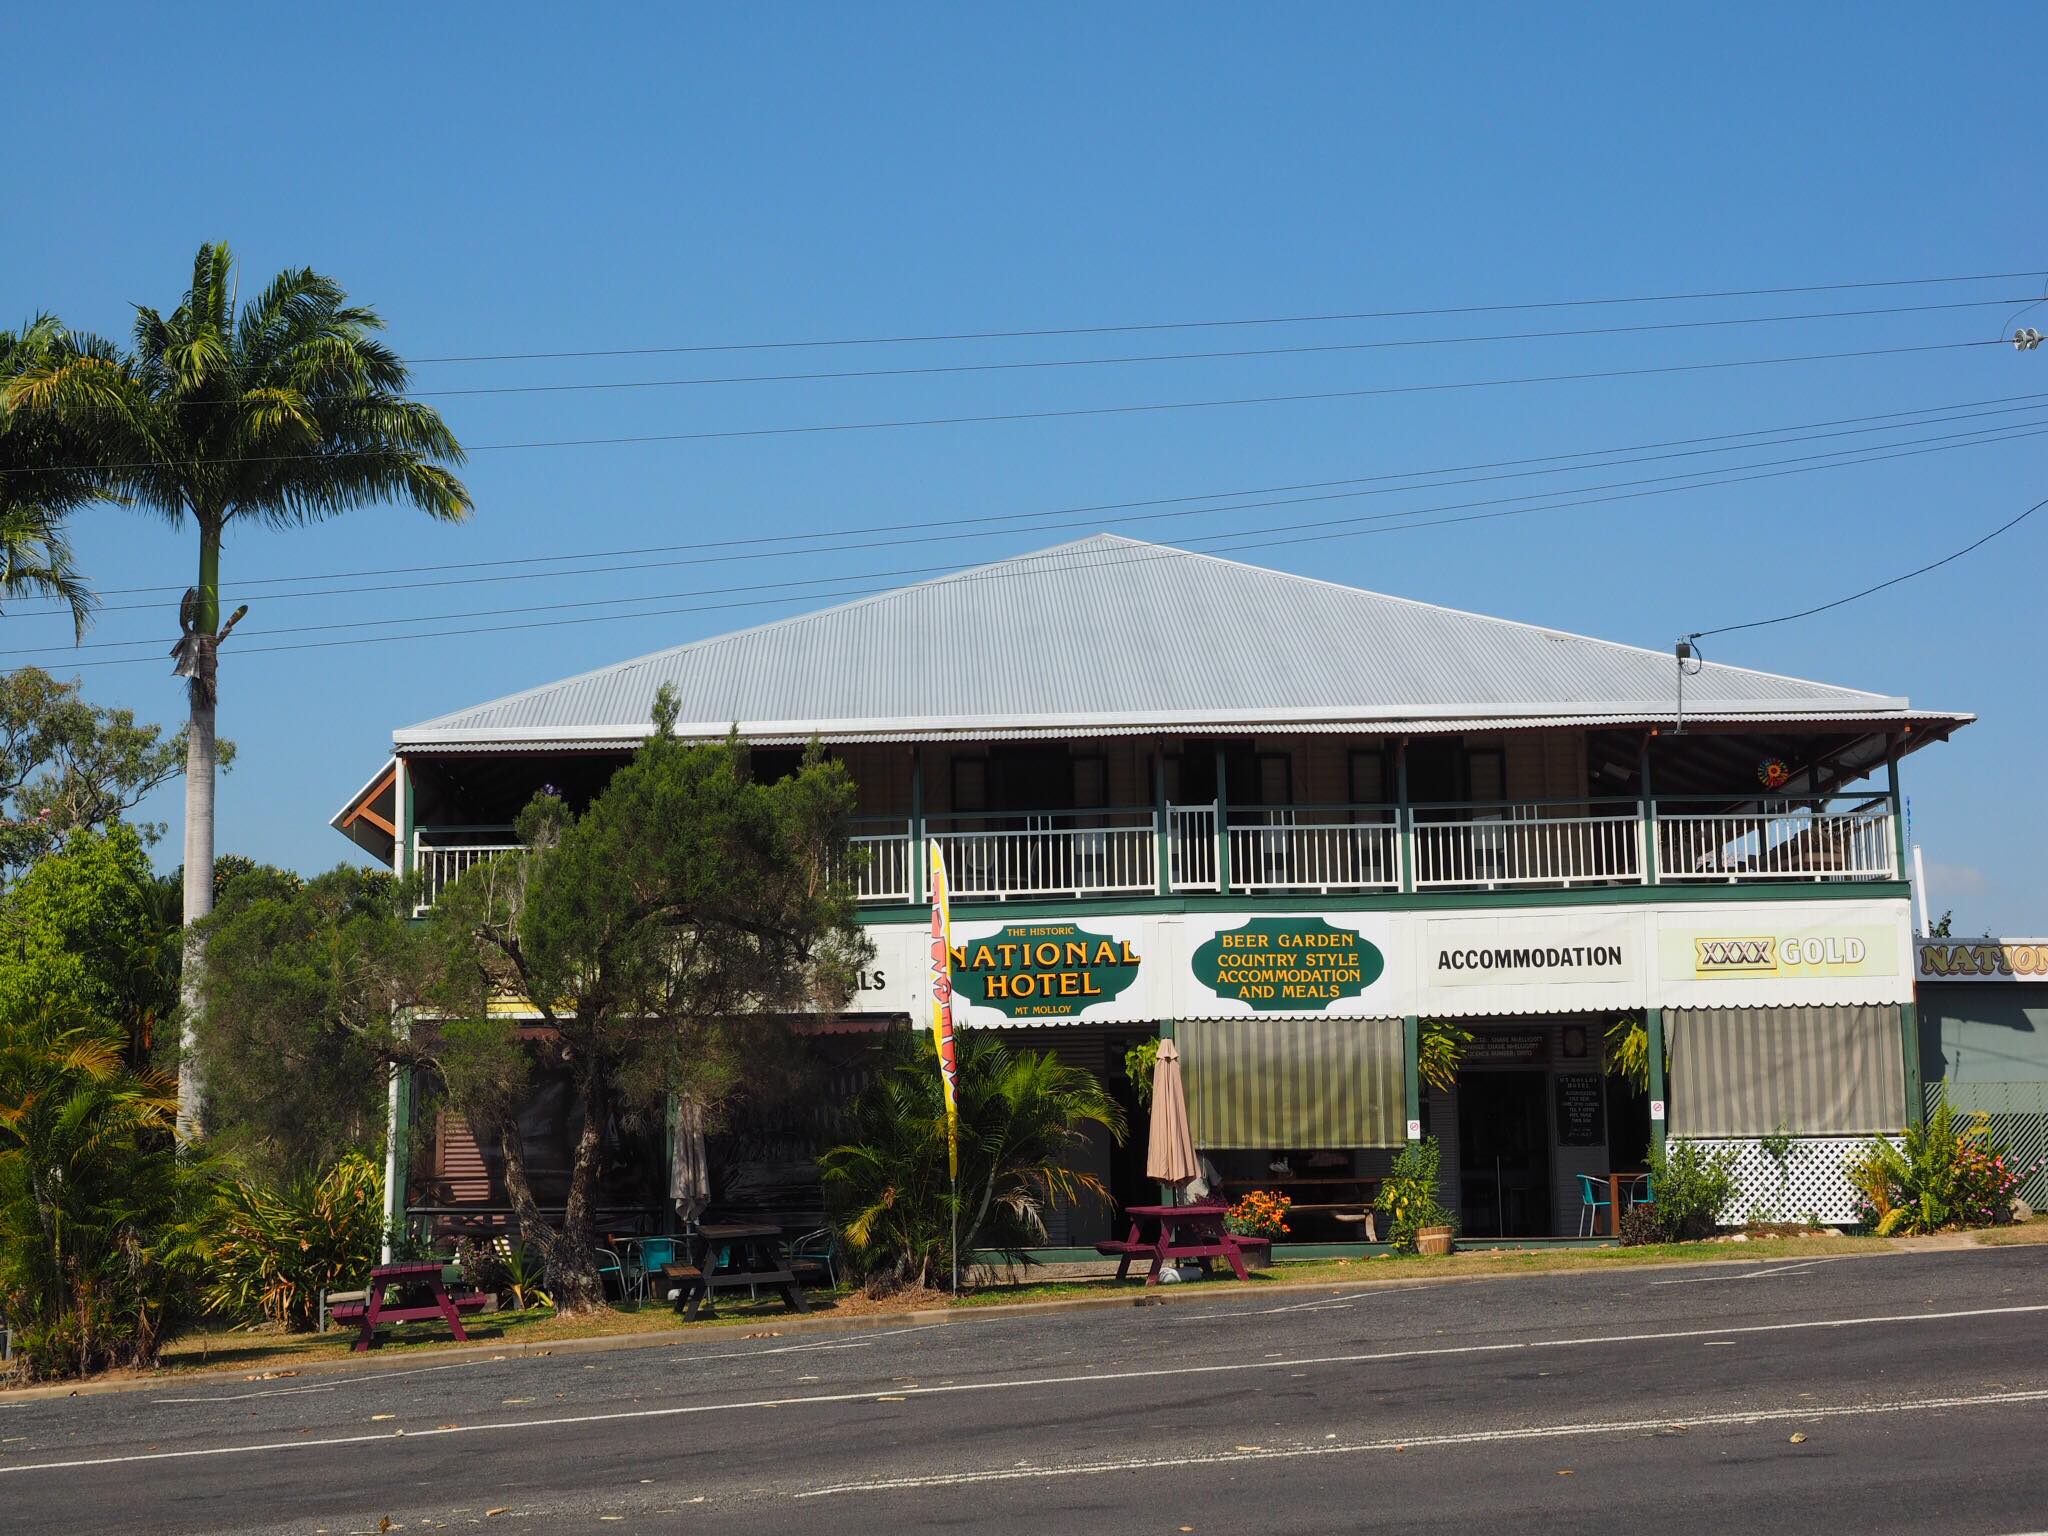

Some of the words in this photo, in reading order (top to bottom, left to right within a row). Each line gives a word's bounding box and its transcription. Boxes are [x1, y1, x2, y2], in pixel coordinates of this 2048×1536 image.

[1007, 929, 1025, 937] THE
[1030, 927, 1074, 936] HISTORIC
[1222, 935, 1269, 948] BEER
[1278, 934, 1354, 947] GARDEN
[950, 940, 1141, 971] NATIONAL
[1438, 946, 1622, 970] ACCOMMODATION
[1700, 940, 1773, 965] XXXX
[1780, 937, 1865, 965] GOLD
[1217, 954, 1297, 967] COUNTRY
[1305, 953, 1359, 966] STYLE
[1216, 969, 1361, 983] ACCOMMODATION
[986, 972, 1101, 999] HOTEL
[1238, 985, 1275, 998] AND
[1282, 985, 1341, 998] MEALS
[1015, 1006, 1028, 1014] MT
[1032, 1005, 1072, 1014] MOLLOY
